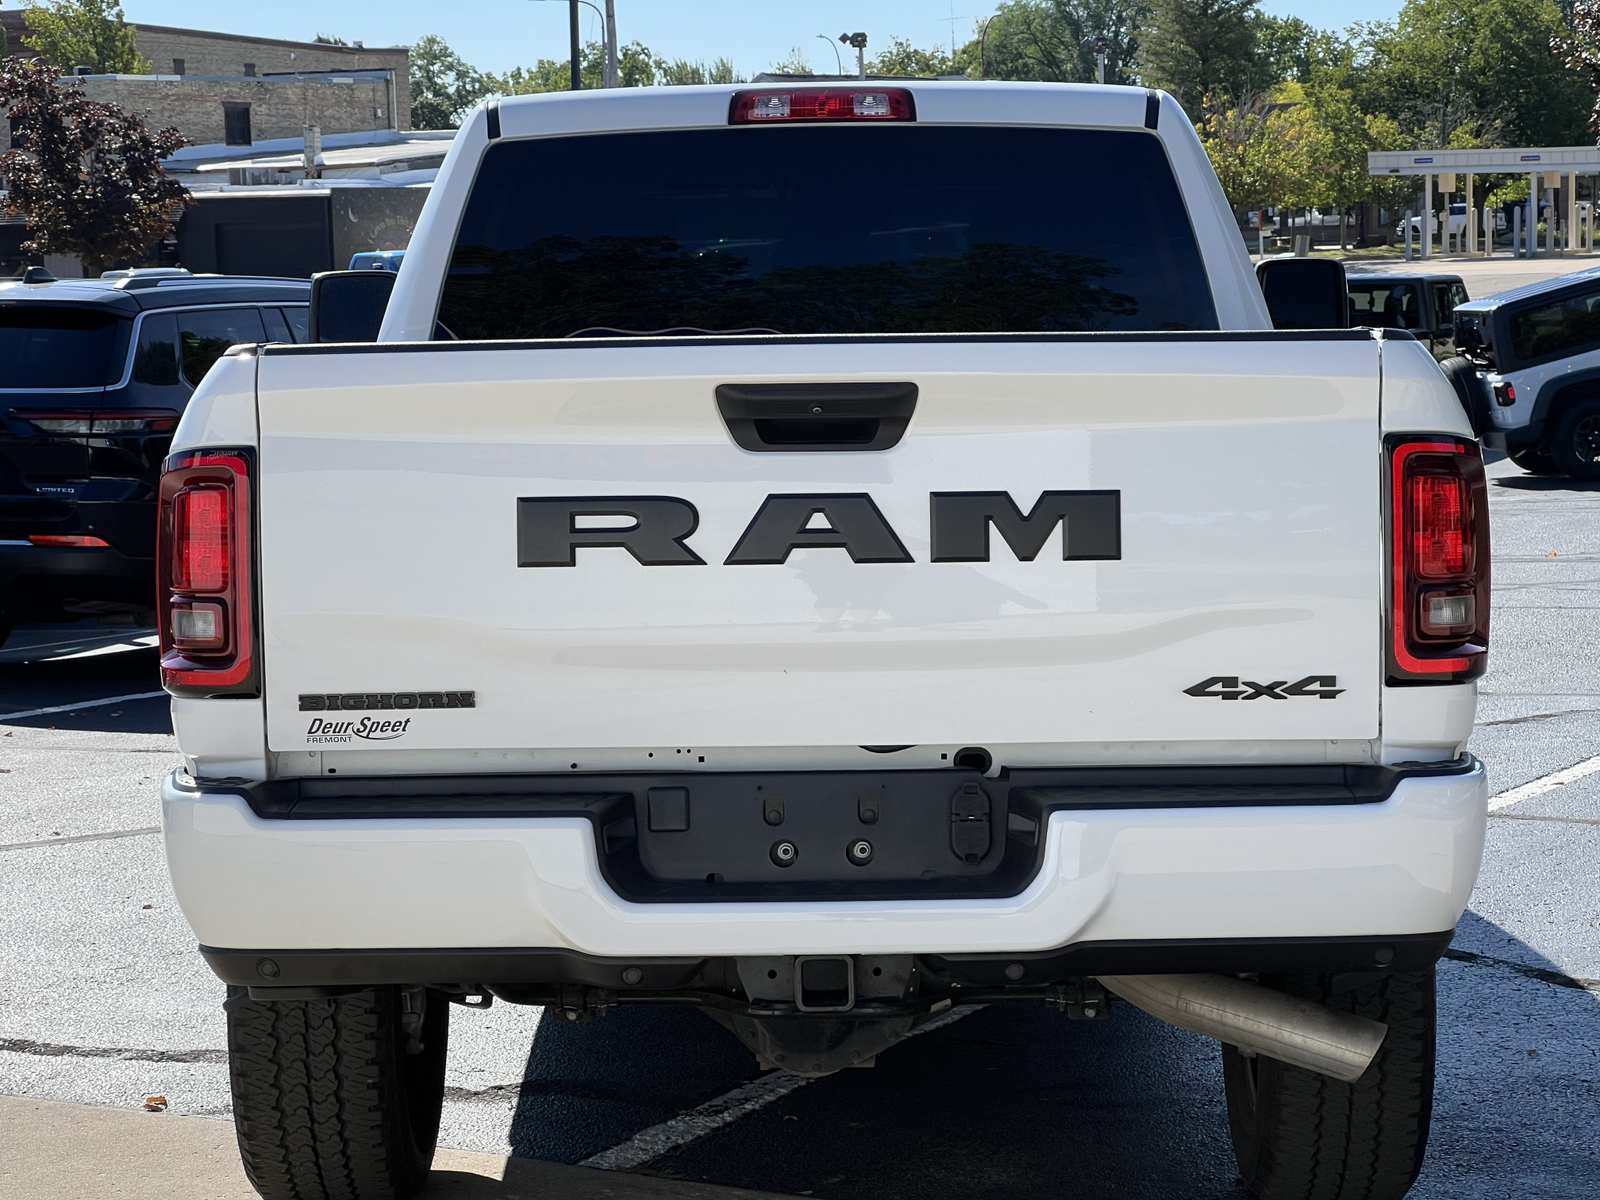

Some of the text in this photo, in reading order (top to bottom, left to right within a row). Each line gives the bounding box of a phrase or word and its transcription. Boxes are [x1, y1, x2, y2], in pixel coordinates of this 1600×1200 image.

[517, 490, 1121, 567] RAM
[1182, 675, 1346, 700] 4x4
[298, 691, 475, 711] BIGHORN
[306, 735, 353, 744] FREMONT
[307, 716, 411, 740] Deur Speet
